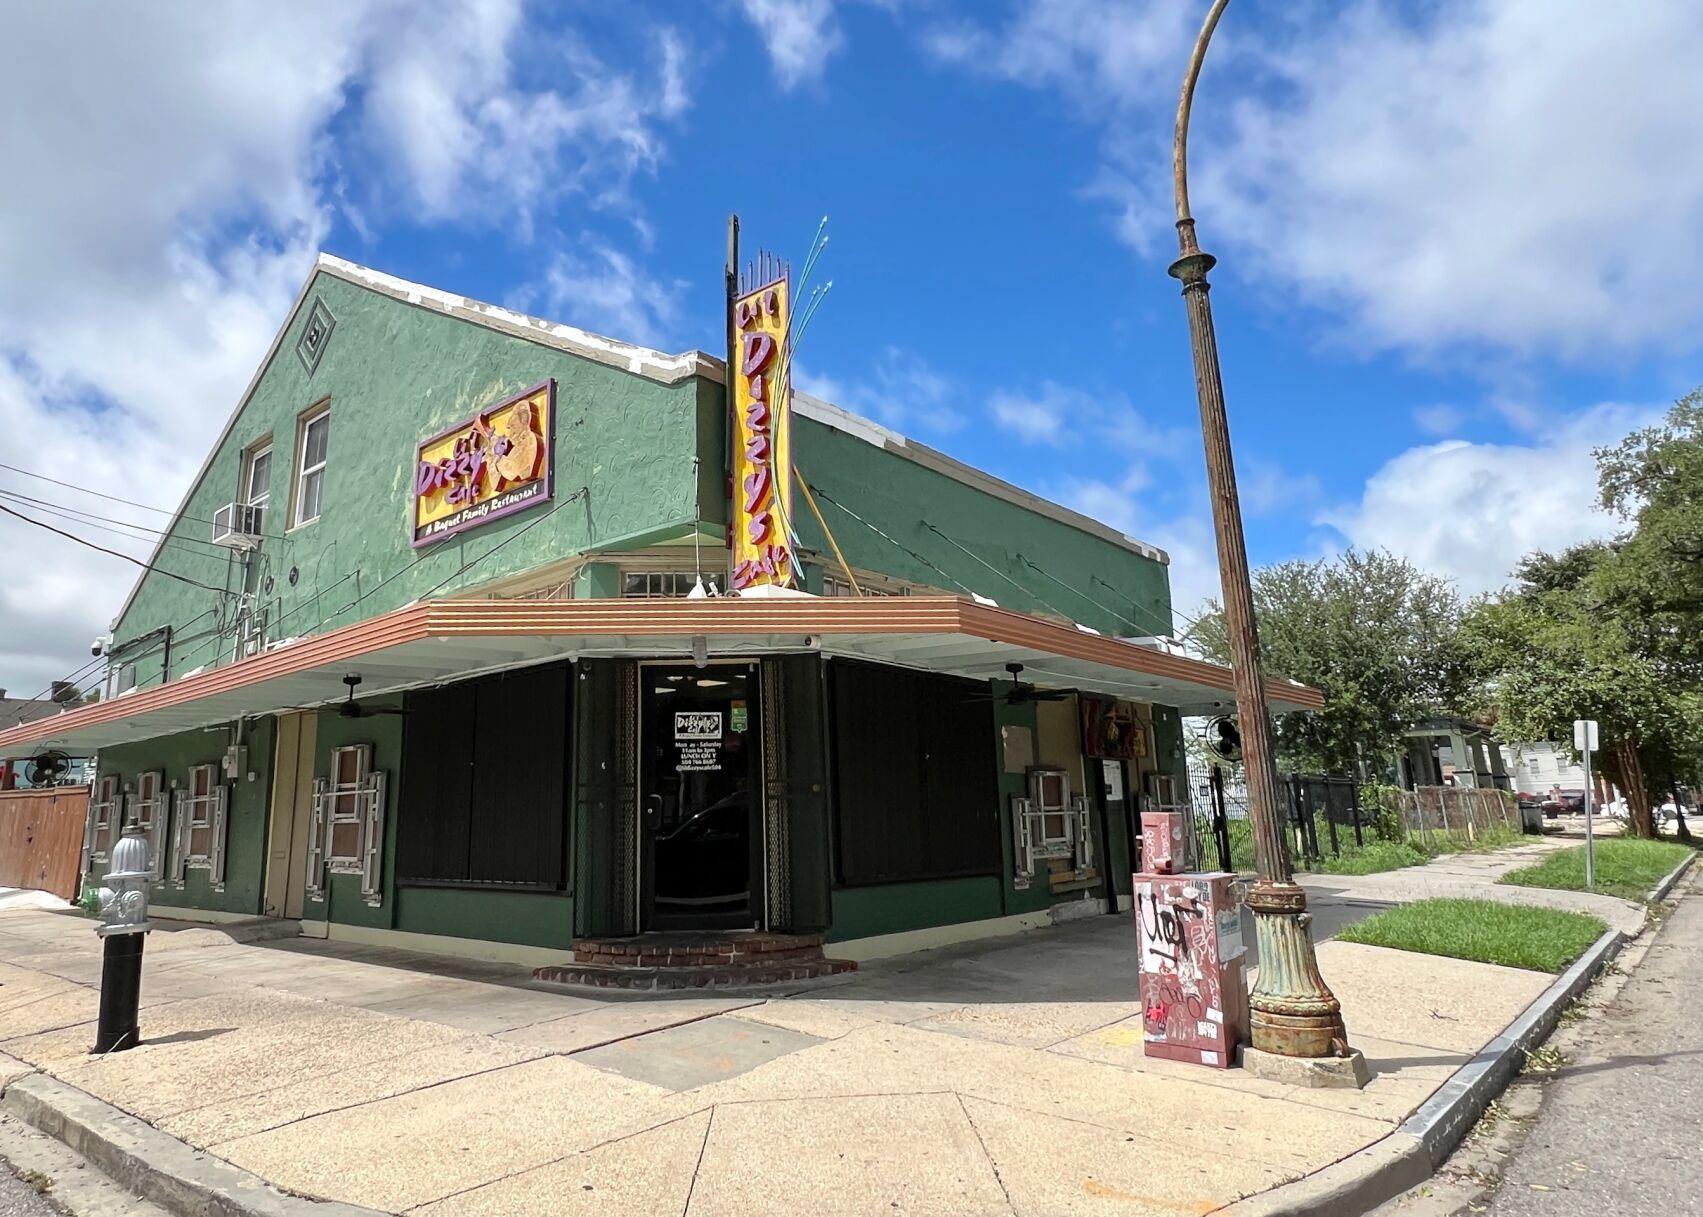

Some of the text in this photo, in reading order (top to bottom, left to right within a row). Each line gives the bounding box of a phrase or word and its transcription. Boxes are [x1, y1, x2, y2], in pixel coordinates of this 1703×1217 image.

[425, 524, 433, 536] A
[462, 503, 489, 521] Family
[491, 483, 538, 511] Restaurant
